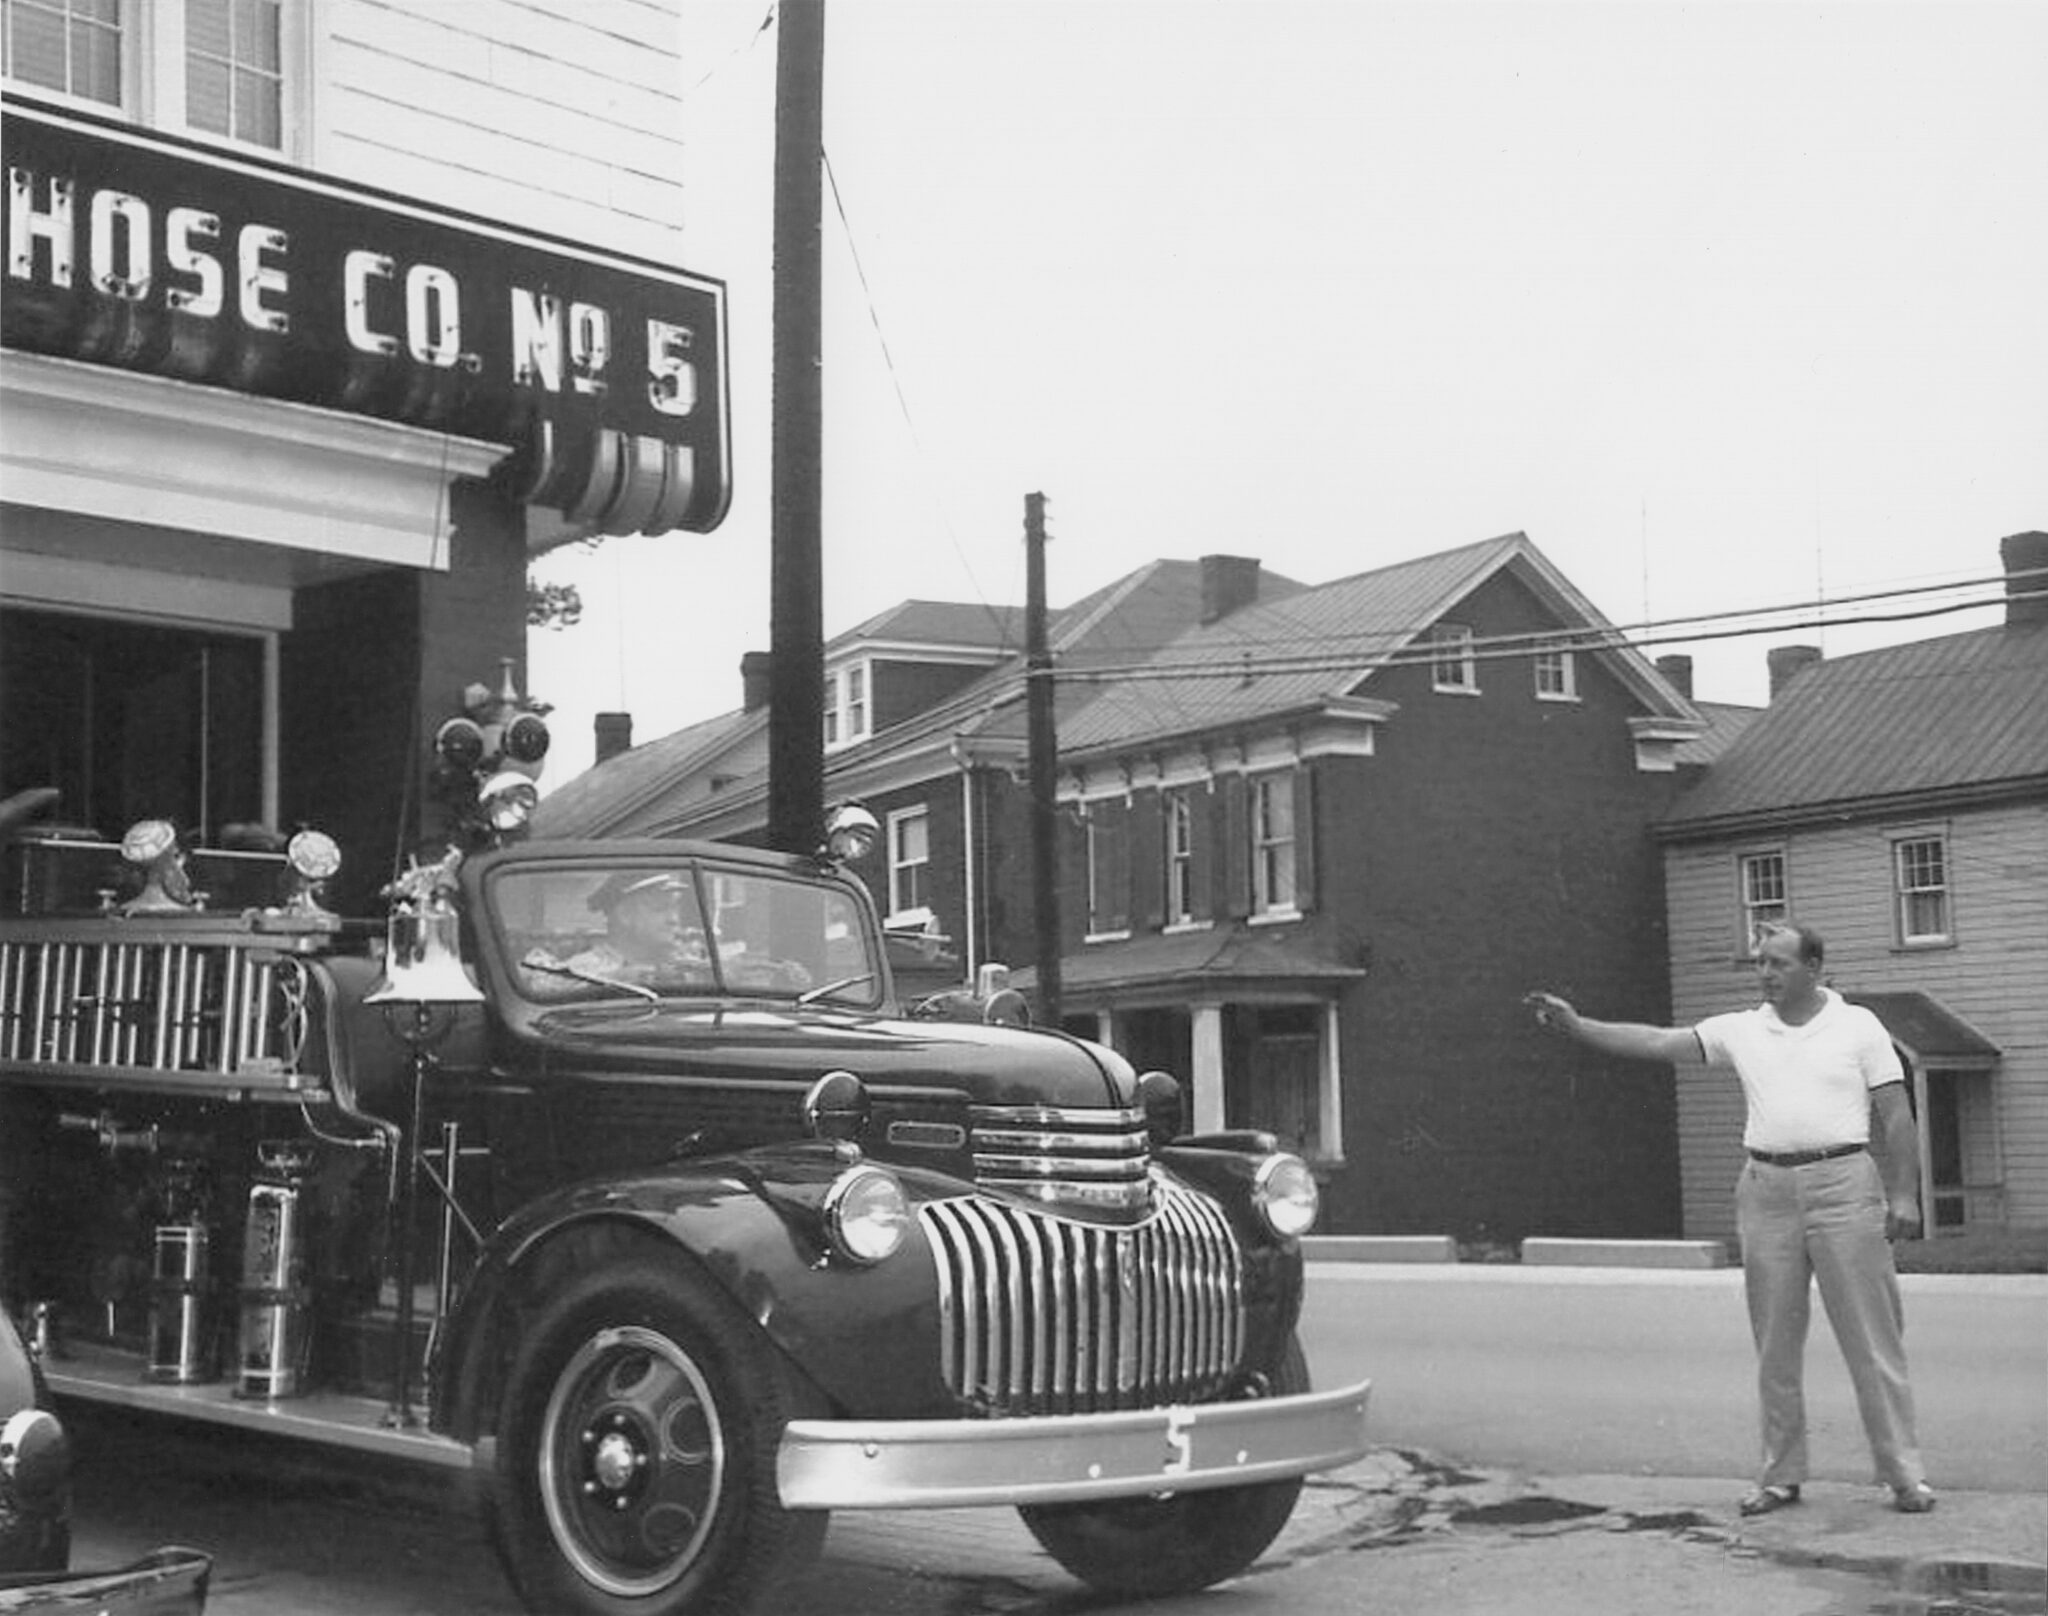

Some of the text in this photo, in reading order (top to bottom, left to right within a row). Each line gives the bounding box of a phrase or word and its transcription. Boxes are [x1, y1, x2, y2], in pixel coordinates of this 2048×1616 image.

[9, 166, 290, 334] HOSE
[344, 250, 482, 373] CO.
[648, 318, 697, 416] 5
[1163, 1405, 1196, 1478] 5
